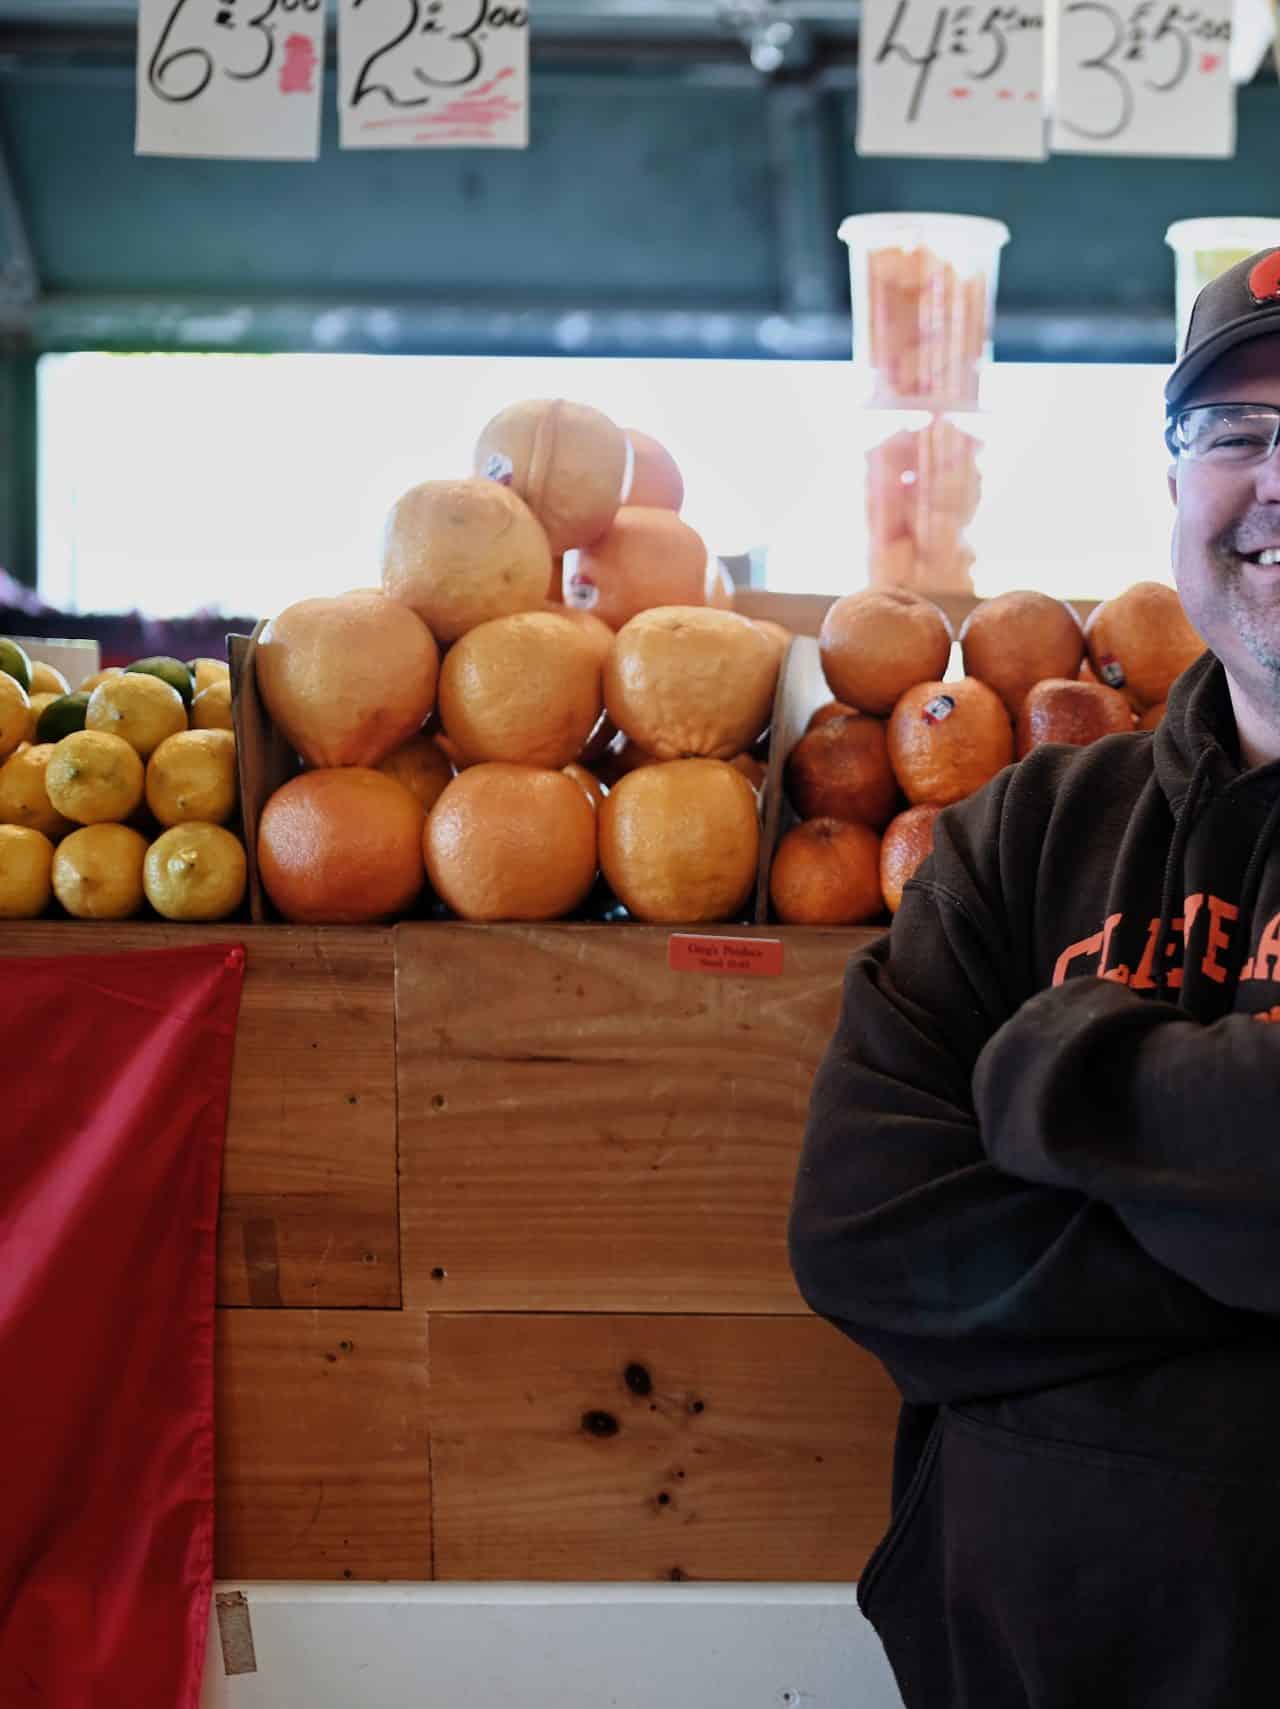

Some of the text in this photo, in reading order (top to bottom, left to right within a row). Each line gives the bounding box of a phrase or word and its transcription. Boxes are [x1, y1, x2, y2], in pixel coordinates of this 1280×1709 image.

[350, 0, 430, 107] 2
[873, 0, 950, 124] 4
[1057, 1, 1135, 141] 3
